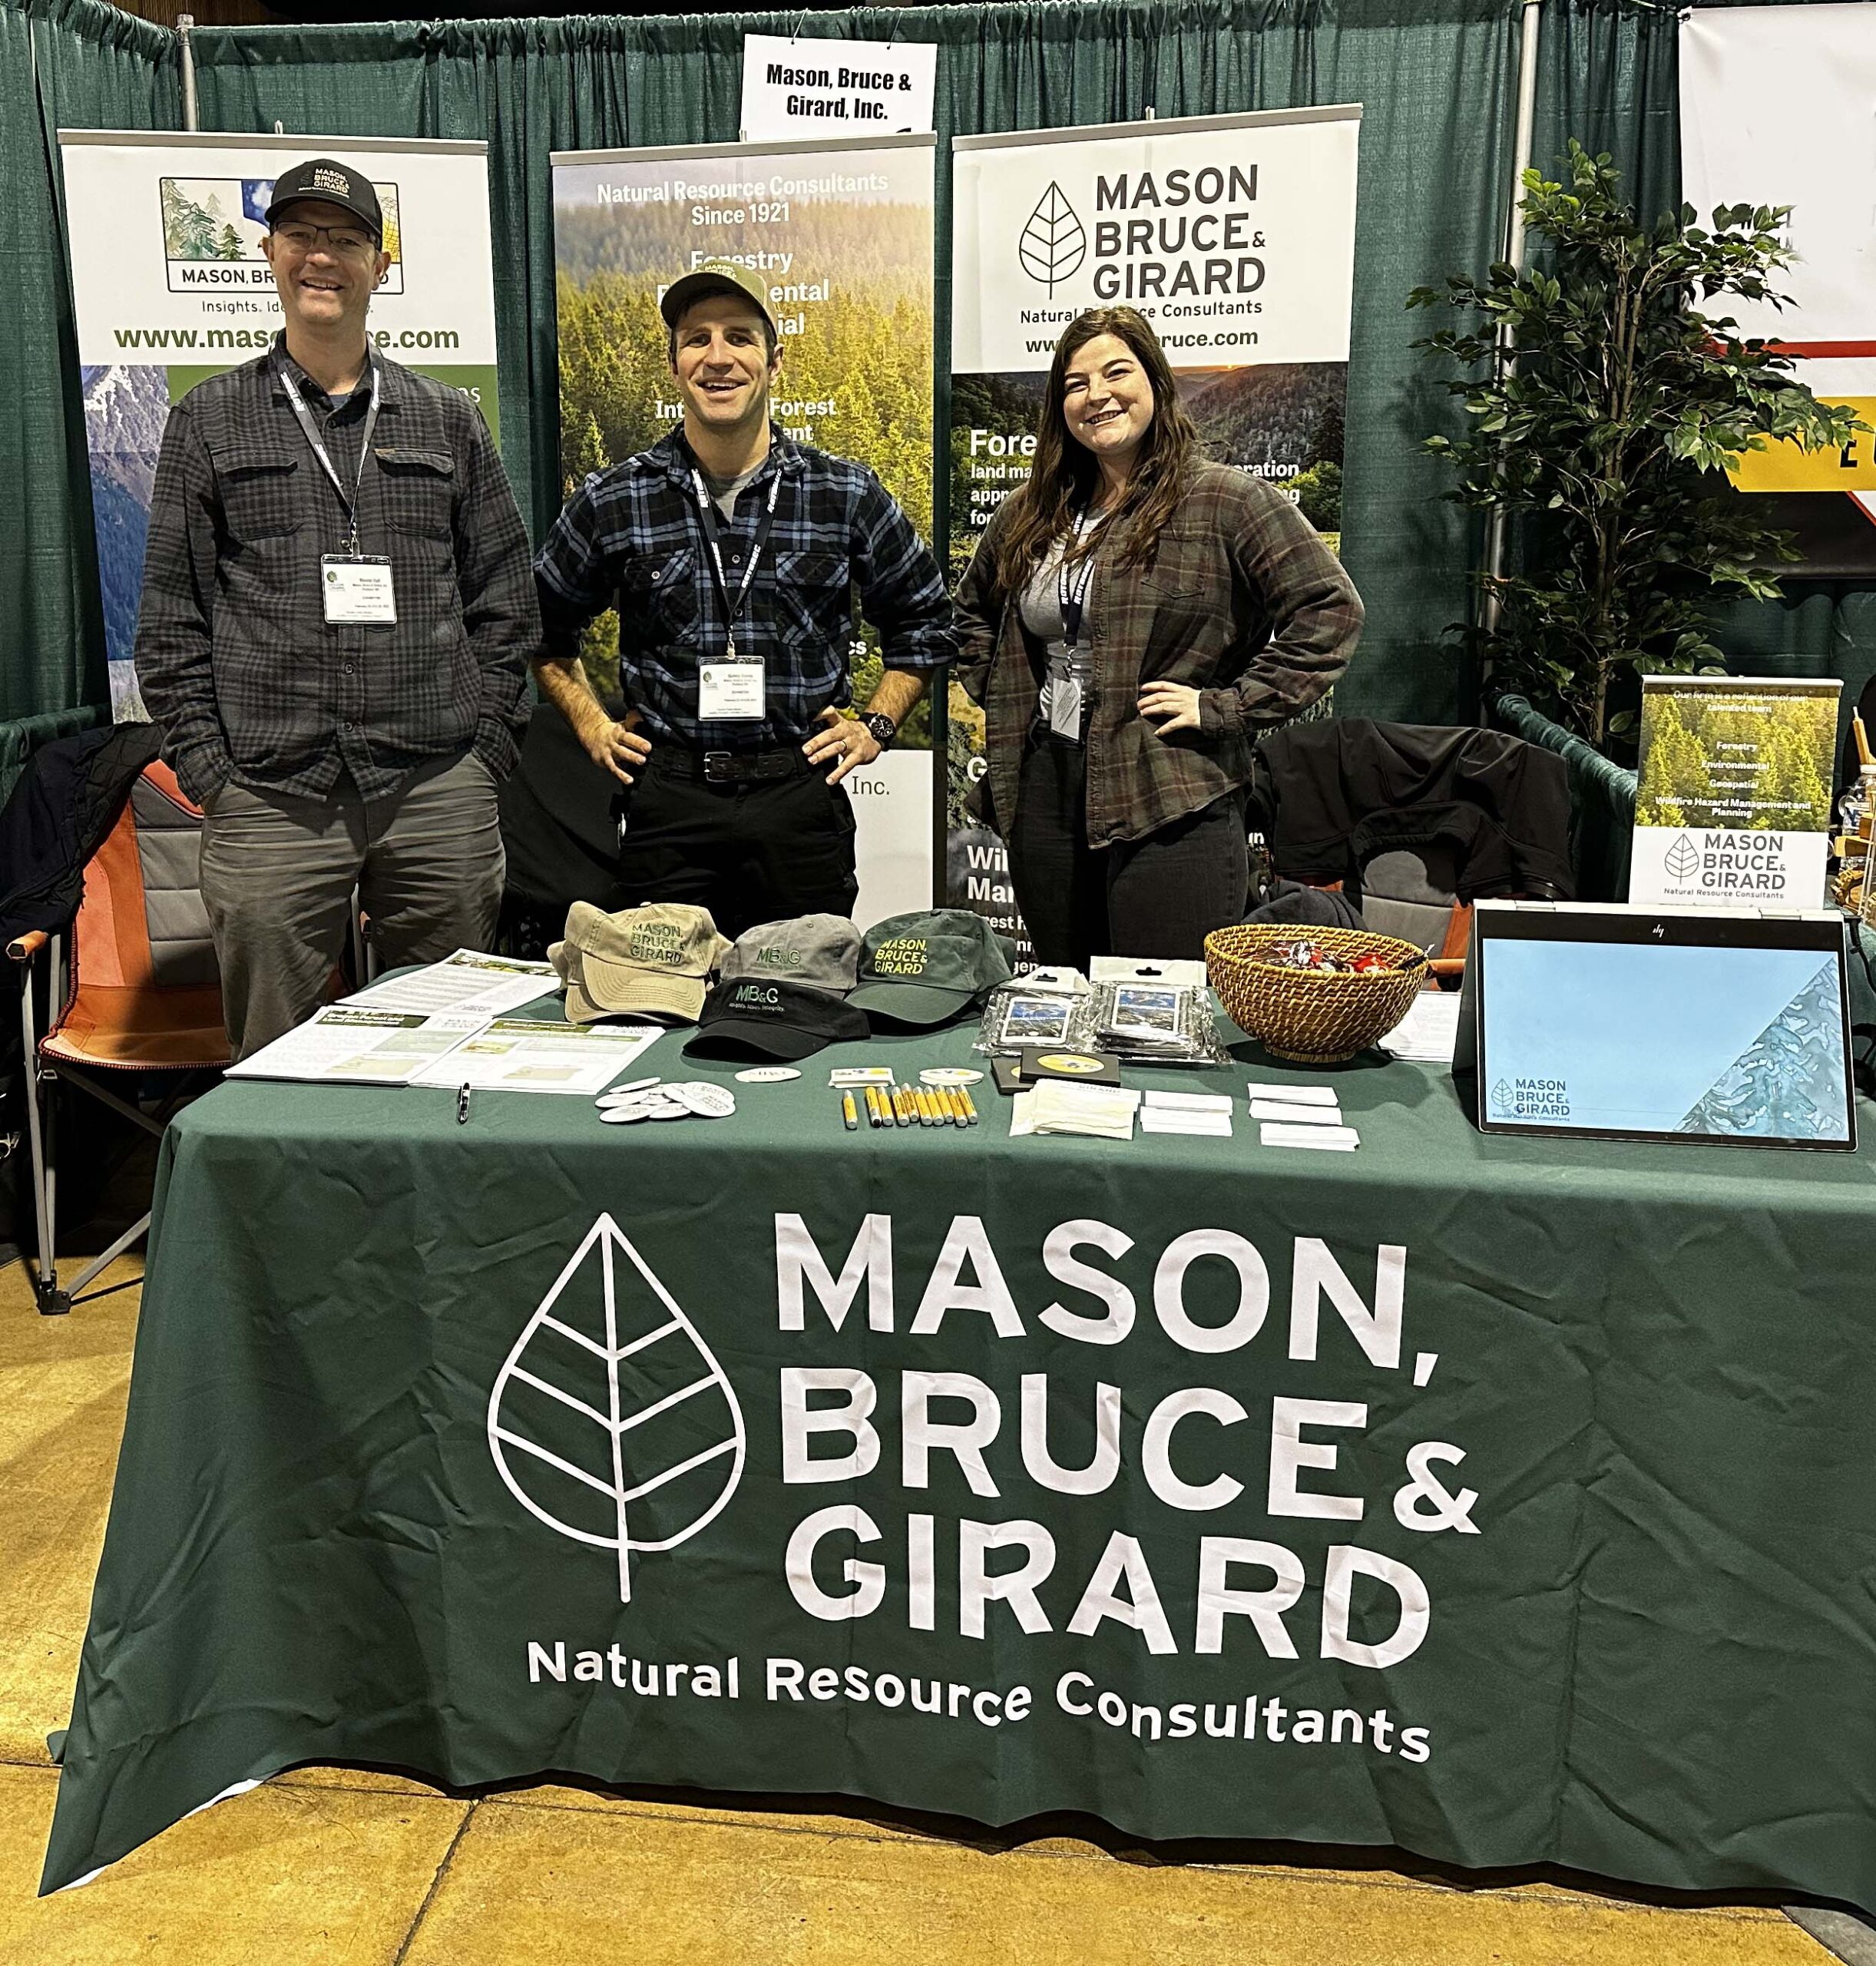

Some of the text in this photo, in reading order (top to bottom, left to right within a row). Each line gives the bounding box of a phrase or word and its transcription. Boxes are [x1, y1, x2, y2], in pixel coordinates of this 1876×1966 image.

[766, 64, 912, 91] Mason, Bruce &
[787, 95, 888, 120] Girard, Inc.
[314, 181, 349, 194] GIRARD
[597, 173, 888, 203] Natural Resource Consultants
[1097, 164, 1258, 210] MASON
[691, 203, 789, 226] Since 1921
[1095, 213, 1249, 257] BRUCE
[183, 270, 248, 285] MASON,
[1094, 257, 1266, 300] GIRARD
[203, 301, 262, 315] Insights.
[1021, 308, 1077, 324] Natural
[1163, 300, 1262, 317] Consultants
[769, 398, 837, 415] Forest
[971, 463, 1005, 478] land
[1716, 742, 1758, 752] Forestry
[1701, 760, 1769, 770] Environmental
[852, 776, 890, 796] Inc.
[1709, 779, 1759, 789] Geospatial
[1656, 796, 1693, 806] Wildfire
[1694, 797, 1729, 807] Hazard
[1730, 799, 1792, 809] Management
[1712, 808, 1752, 819] Planning
[1705, 833, 1783, 851] MASON
[1704, 853, 1778, 871] BRUCE
[1702, 872, 1785, 889] GIRARD
[881, 939, 927, 952] MASON,
[630, 945, 682, 964] GIRARD
[756, 948, 801, 965] MB&G
[875, 949, 921, 962] BRUCE
[875, 961, 922, 974] GIRARD
[736, 985, 779, 1003] MB&G
[1516, 1079, 1566, 1091] MASON
[1517, 1091, 1563, 1104] BRUCE
[1517, 1104, 1570, 1115] GIRARD
[774, 1213, 1438, 1386] MASON,
[780, 1367, 1482, 1534] BRUCE &
[786, 1504, 1431, 1669] GIRARD
[527, 1640, 1431, 1762] Natural Resource Consultants
